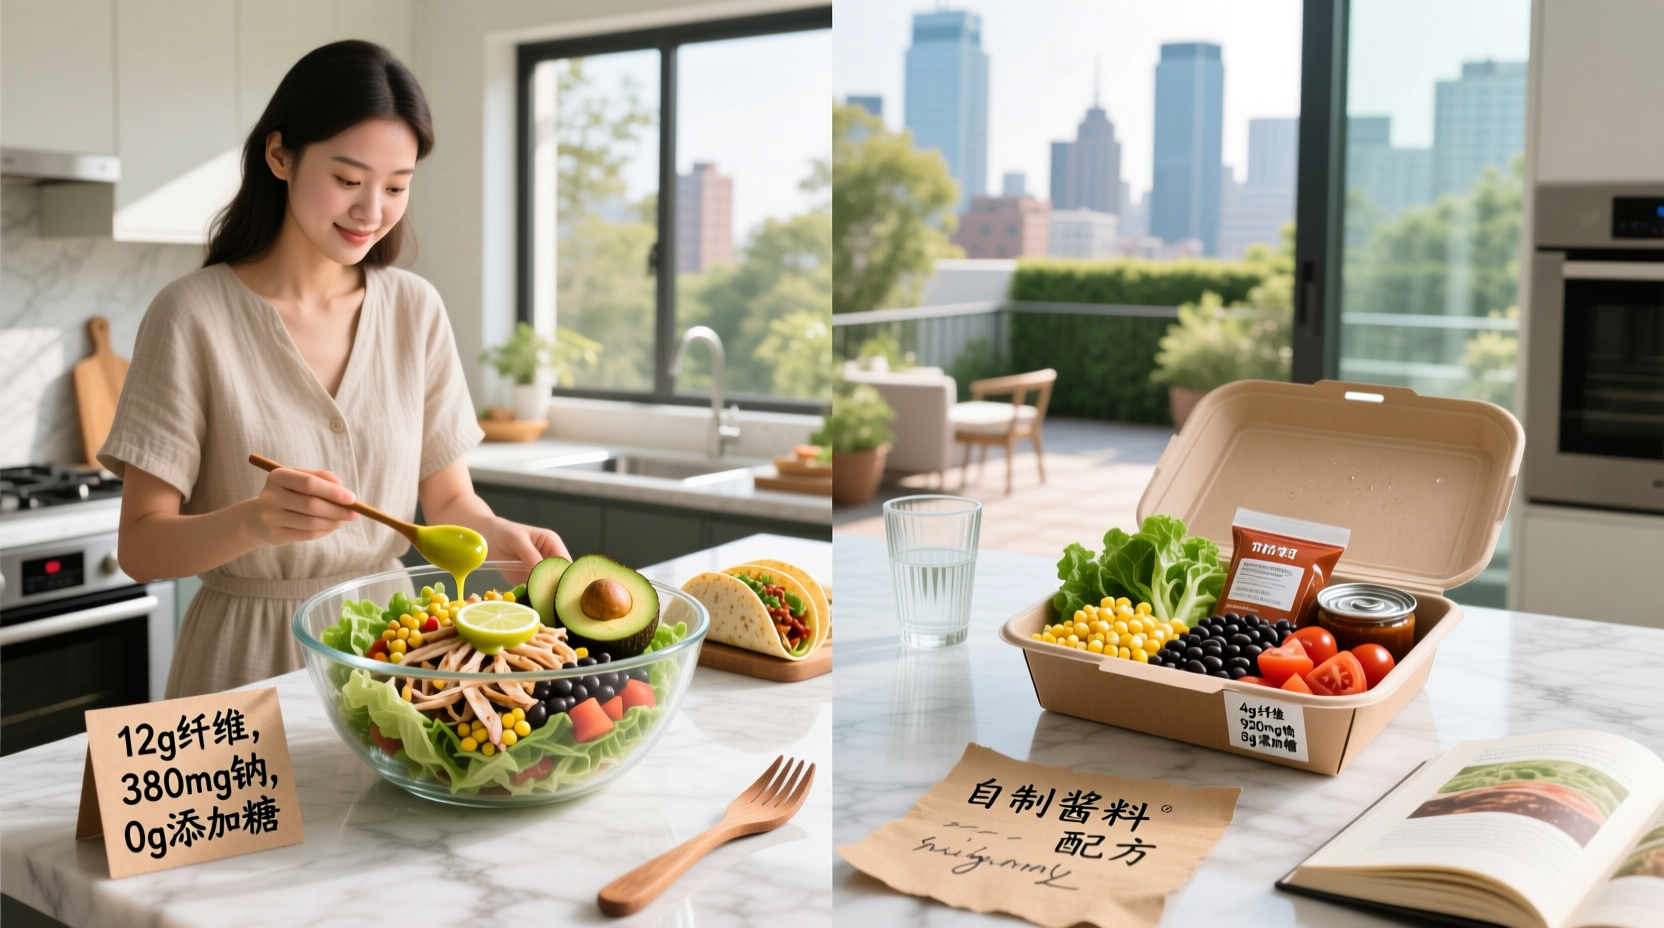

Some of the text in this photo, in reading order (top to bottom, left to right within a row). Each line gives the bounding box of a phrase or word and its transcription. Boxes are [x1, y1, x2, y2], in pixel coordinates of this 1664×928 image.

[117, 708, 260, 761] 12g纤维，
[121, 752, 278, 805] 380mg钠，
[967, 777, 1150, 832] 自制酱料
[124, 795, 280, 859] 0g添加糖
[1053, 831, 1157, 866] 配方
